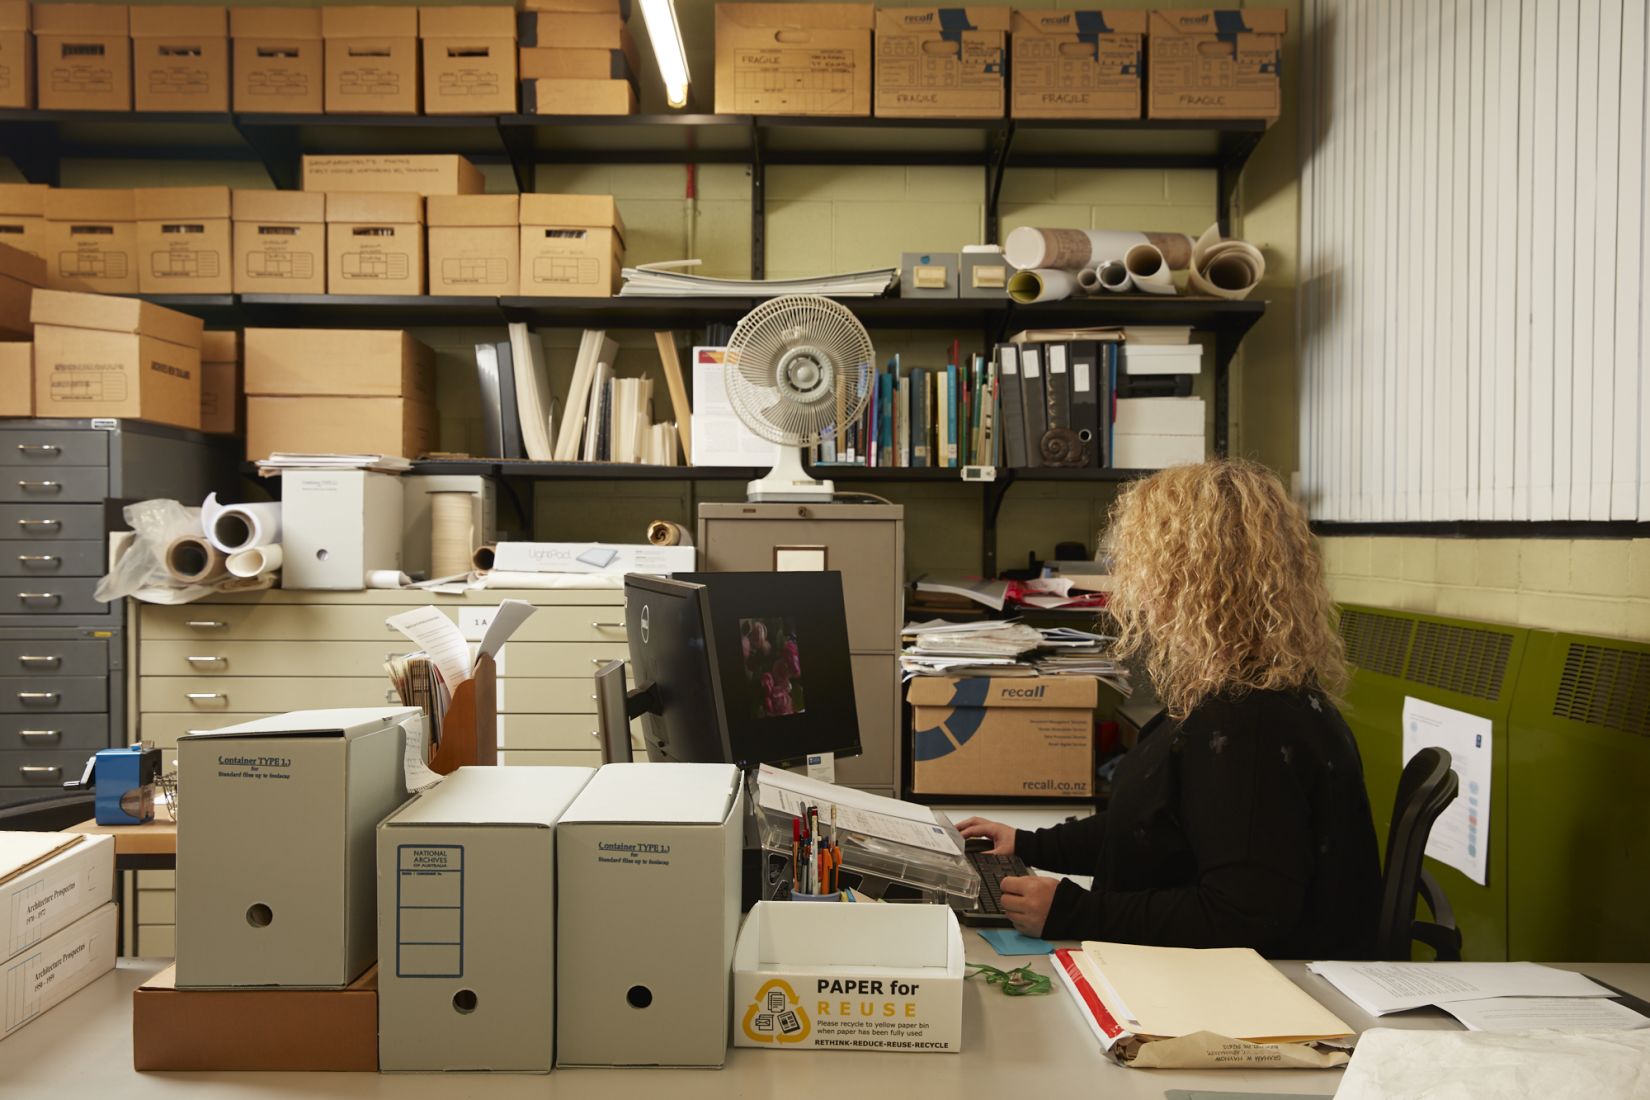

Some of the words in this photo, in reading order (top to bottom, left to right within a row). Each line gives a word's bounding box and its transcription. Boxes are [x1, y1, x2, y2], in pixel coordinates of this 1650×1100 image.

[904, 12, 935, 24] recall
[741, 56, 780, 65] FRAGILE
[896, 94, 938, 104] FRAGILE
[1041, 94, 1089, 104] FRAGILE
[1179, 94, 1225, 105] FRAGILE
[1001, 685, 1046, 698] recall
[218, 756, 256, 766] Container
[258, 757, 280, 767] TYPE
[1022, 779, 1087, 791] recall.co.nz
[598, 842, 636, 852] Container
[637, 843, 659, 853] TYPE
[27, 894, 53, 914] Architecture
[54, 882, 76, 900] Prospectus
[35, 959, 62, 981] Architecture
[62, 944, 85, 963] Prospectus
[817, 979, 884, 995] PAPER
[890, 980, 920, 996] for
[817, 1000, 917, 1018] REUSE
[817, 1020, 839, 1028] Please
[840, 1020, 864, 1029] recycle
[875, 1021, 896, 1030] yellow
[890, 1030, 905, 1038] fully
